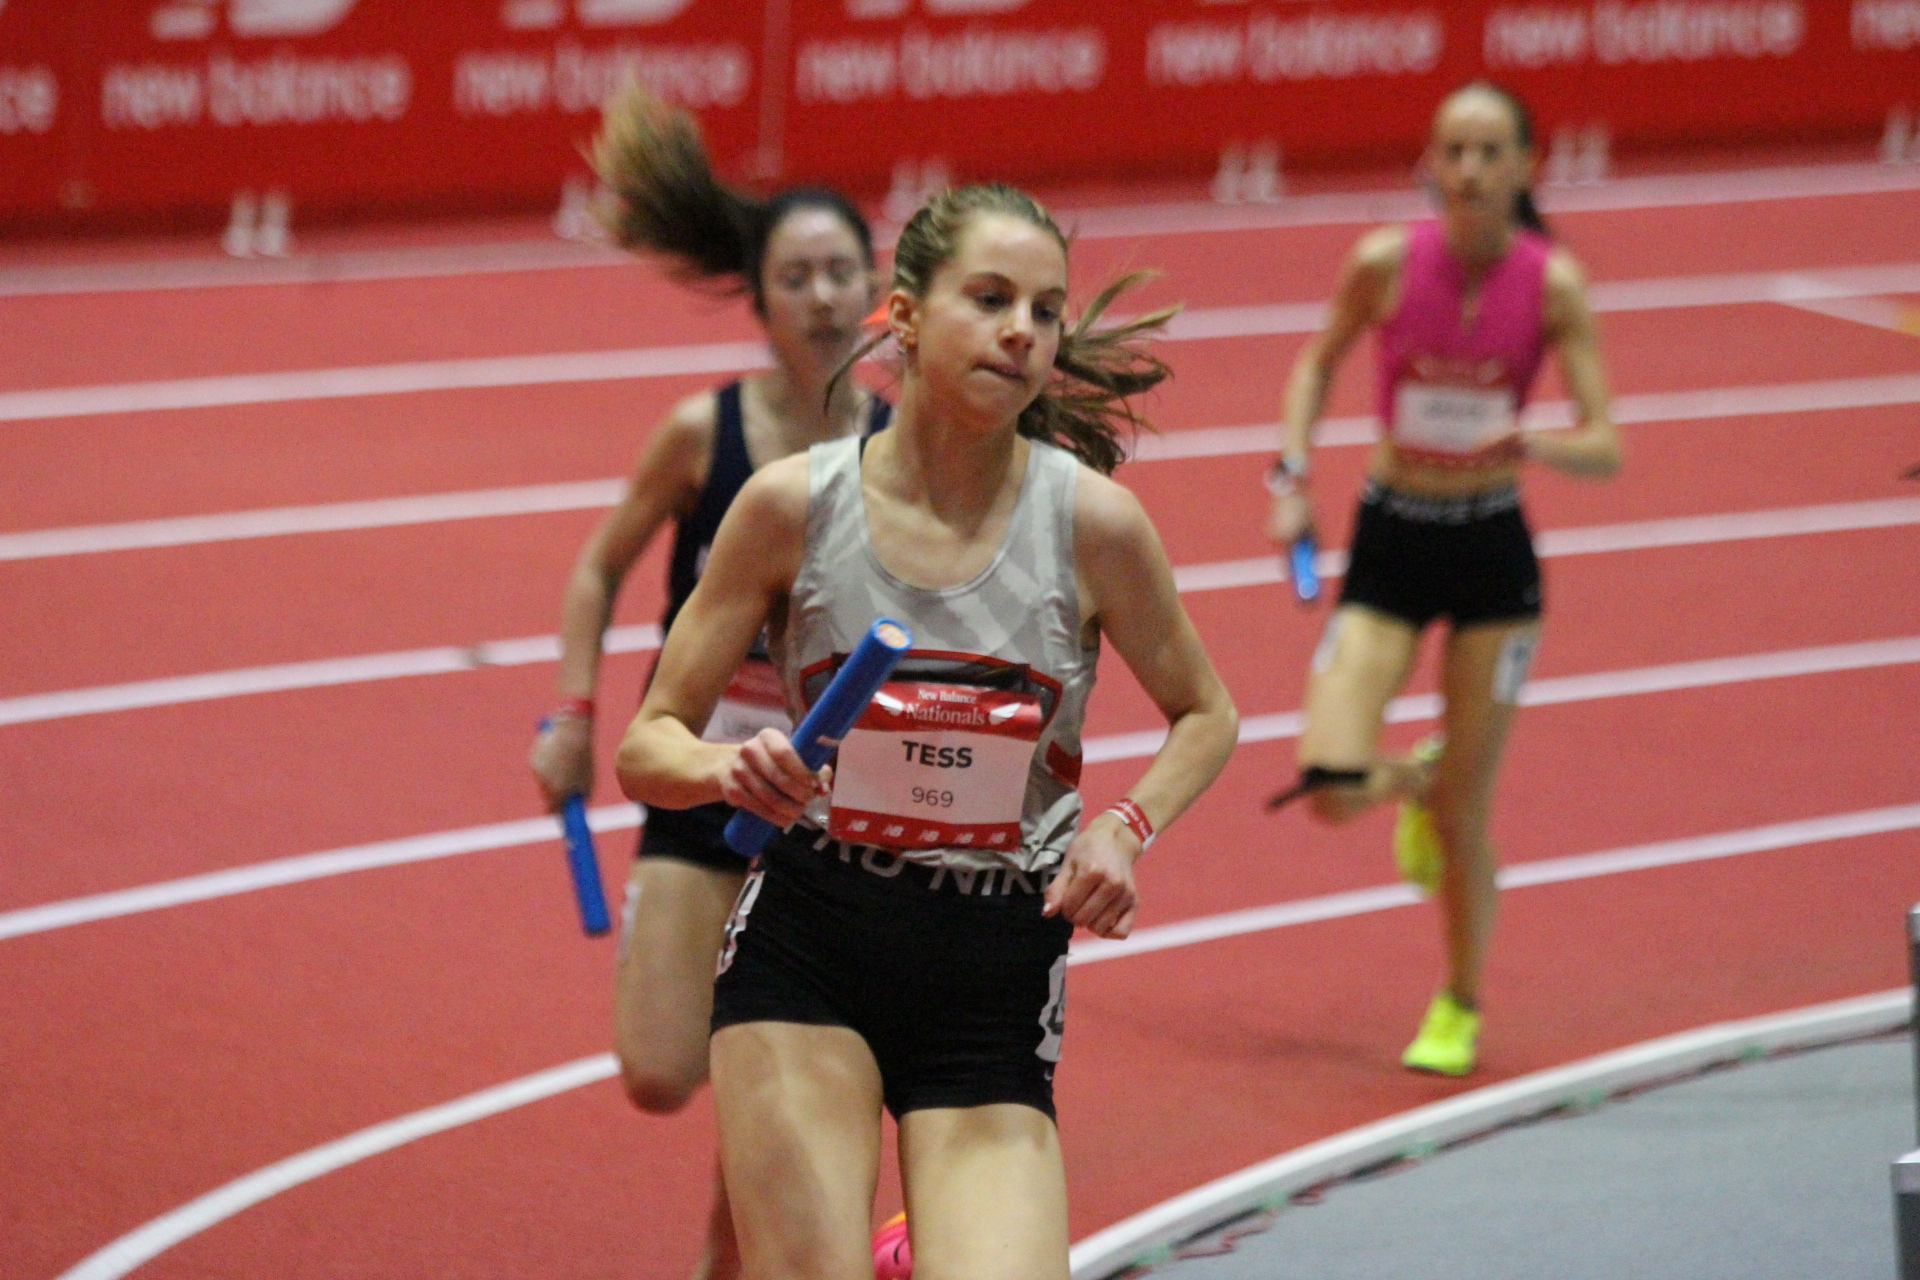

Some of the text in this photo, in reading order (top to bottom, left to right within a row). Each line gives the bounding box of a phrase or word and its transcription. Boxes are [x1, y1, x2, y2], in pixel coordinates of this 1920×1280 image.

[918, 689, 977, 704] New Balance
[905, 702, 985, 726] Nationals
[902, 740, 973, 769] TESS
[911, 786, 954, 808] 969
